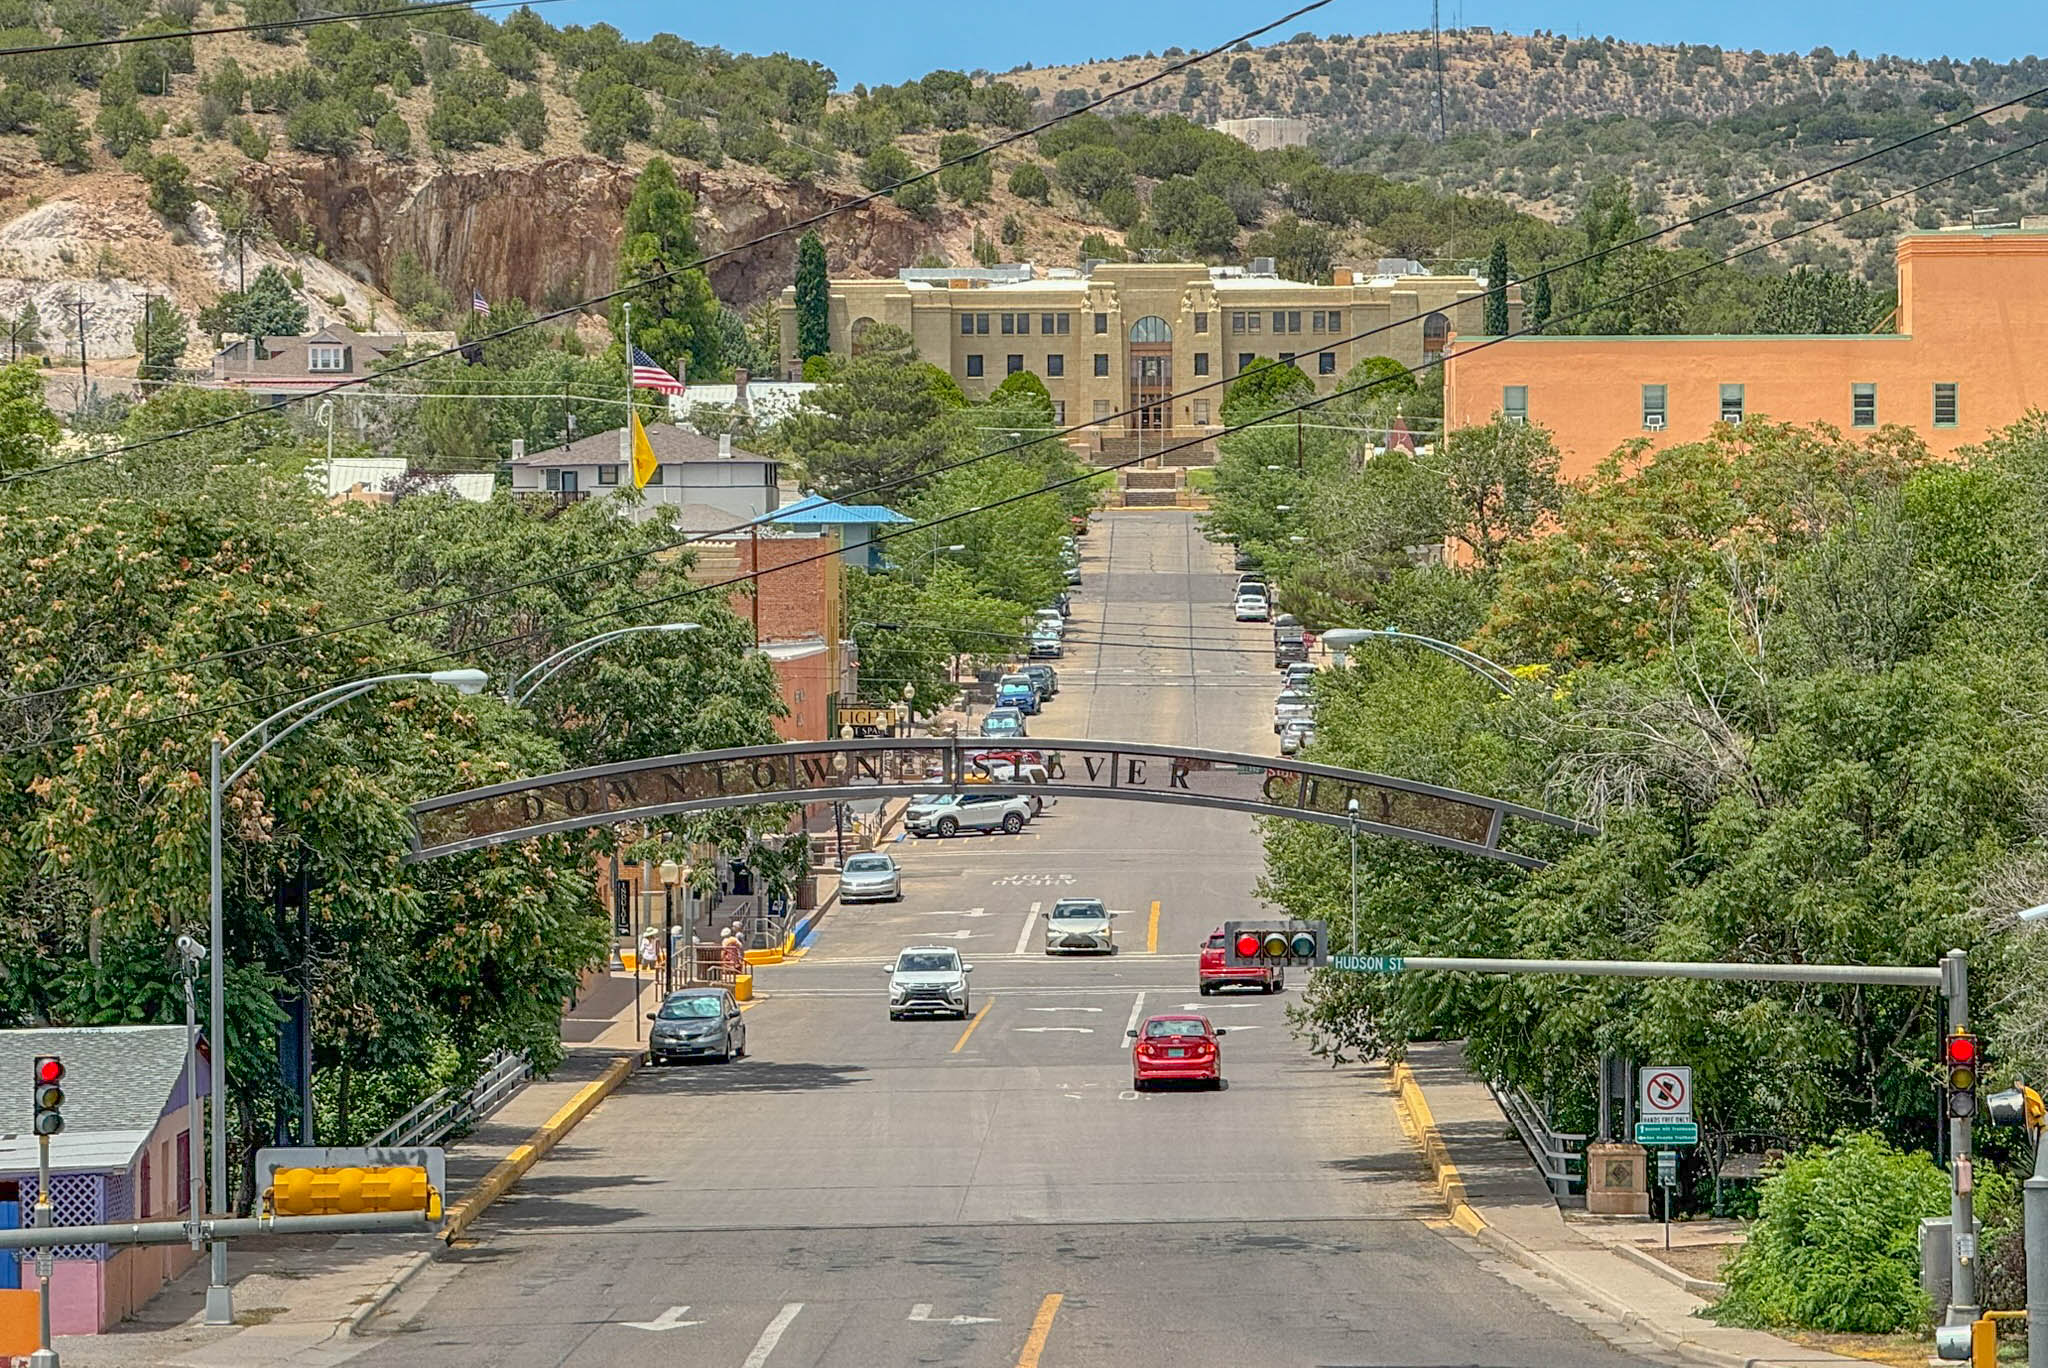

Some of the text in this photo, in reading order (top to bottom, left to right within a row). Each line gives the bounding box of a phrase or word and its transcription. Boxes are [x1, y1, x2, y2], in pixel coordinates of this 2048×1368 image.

[839, 711, 892, 724] LIGHT
[861, 727, 889, 736] SPAE
[522, 755, 879, 821] DOWNTOWN
[972, 753, 1190, 789] SILVER
[1262, 774, 1395, 818] CITY
[1335, 956, 1402, 970] HUDSON ST
